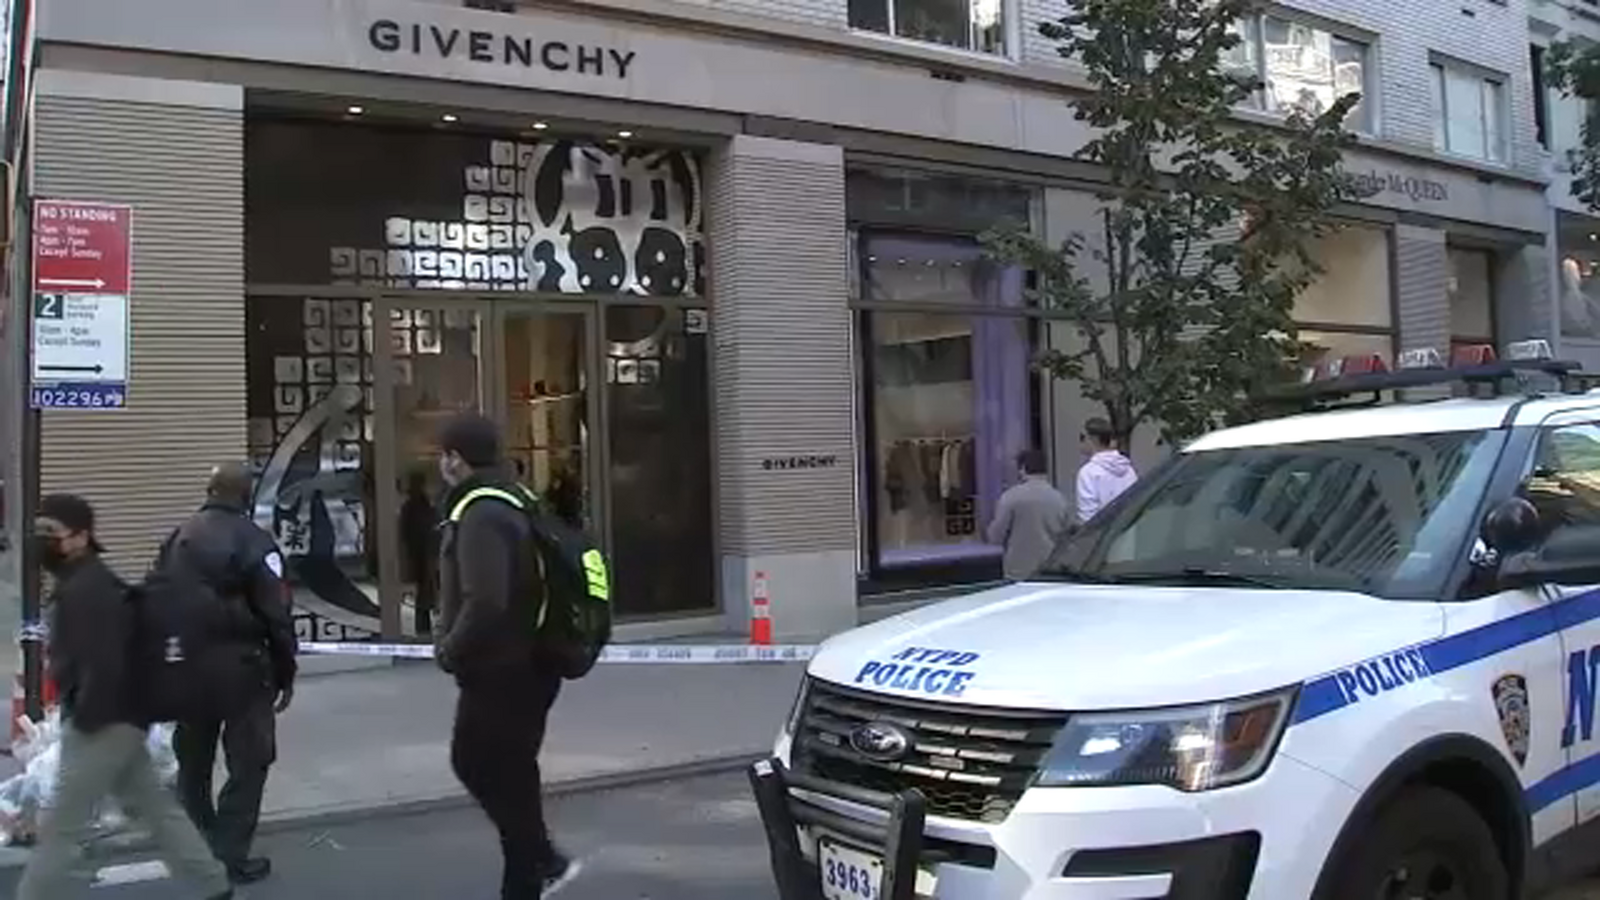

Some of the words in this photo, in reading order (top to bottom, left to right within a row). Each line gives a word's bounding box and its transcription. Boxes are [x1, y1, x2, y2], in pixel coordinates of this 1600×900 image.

[368, 19, 636, 79] GIVENCHY
[40, 207, 58, 219] NO
[59, 208, 116, 222] STANDING
[41, 295, 56, 316] 2
[762, 455, 836, 470] GIVENCHY
[892, 646, 980, 666] NYPD
[854, 660, 976, 696] POLICE
[1337, 649, 1428, 703] POLICE
[826, 857, 871, 899] 3963
